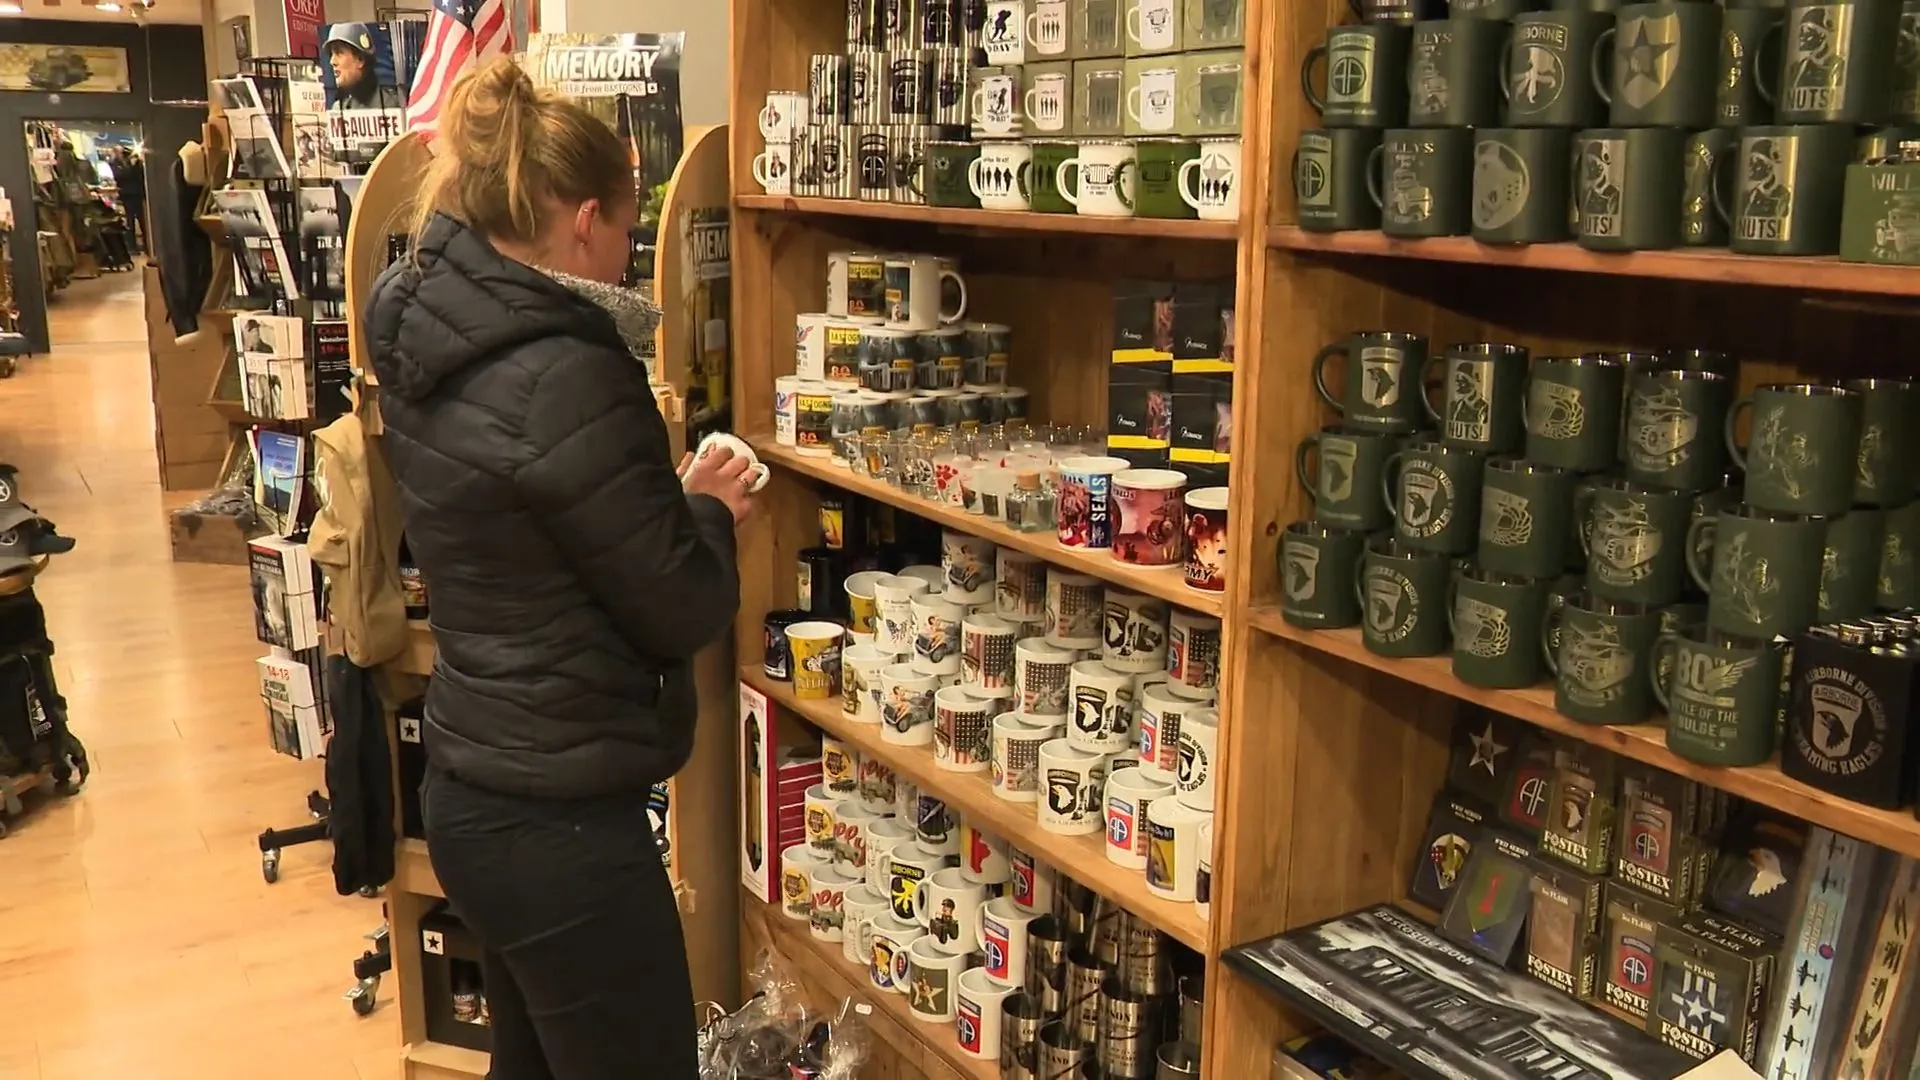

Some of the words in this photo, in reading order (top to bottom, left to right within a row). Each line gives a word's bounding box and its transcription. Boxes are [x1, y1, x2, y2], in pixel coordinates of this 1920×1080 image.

[1521, 24, 1564, 43] BORNE
[546, 51, 659, 79] MEMORY
[581, 84, 602, 95] from
[1584, 214, 1613, 236] UTS!
[1739, 217, 1783, 239] NUTS!
[1447, 421, 1484, 440] NUTS!
[1090, 476, 1107, 522] SEALS
[1678, 647, 1714, 691] 80
[1717, 710, 1739, 724] THE
[1543, 829, 1588, 860] FOSTEX
[1619, 858, 1671, 891] FOSTEX
[1700, 930, 1745, 952] FLASK
[1721, 924, 1765, 948] FLASK
[1528, 953, 1574, 988] FOSTEX
[1694, 963, 1717, 981] FLASK
[1606, 981, 1650, 1012] FOSTE
